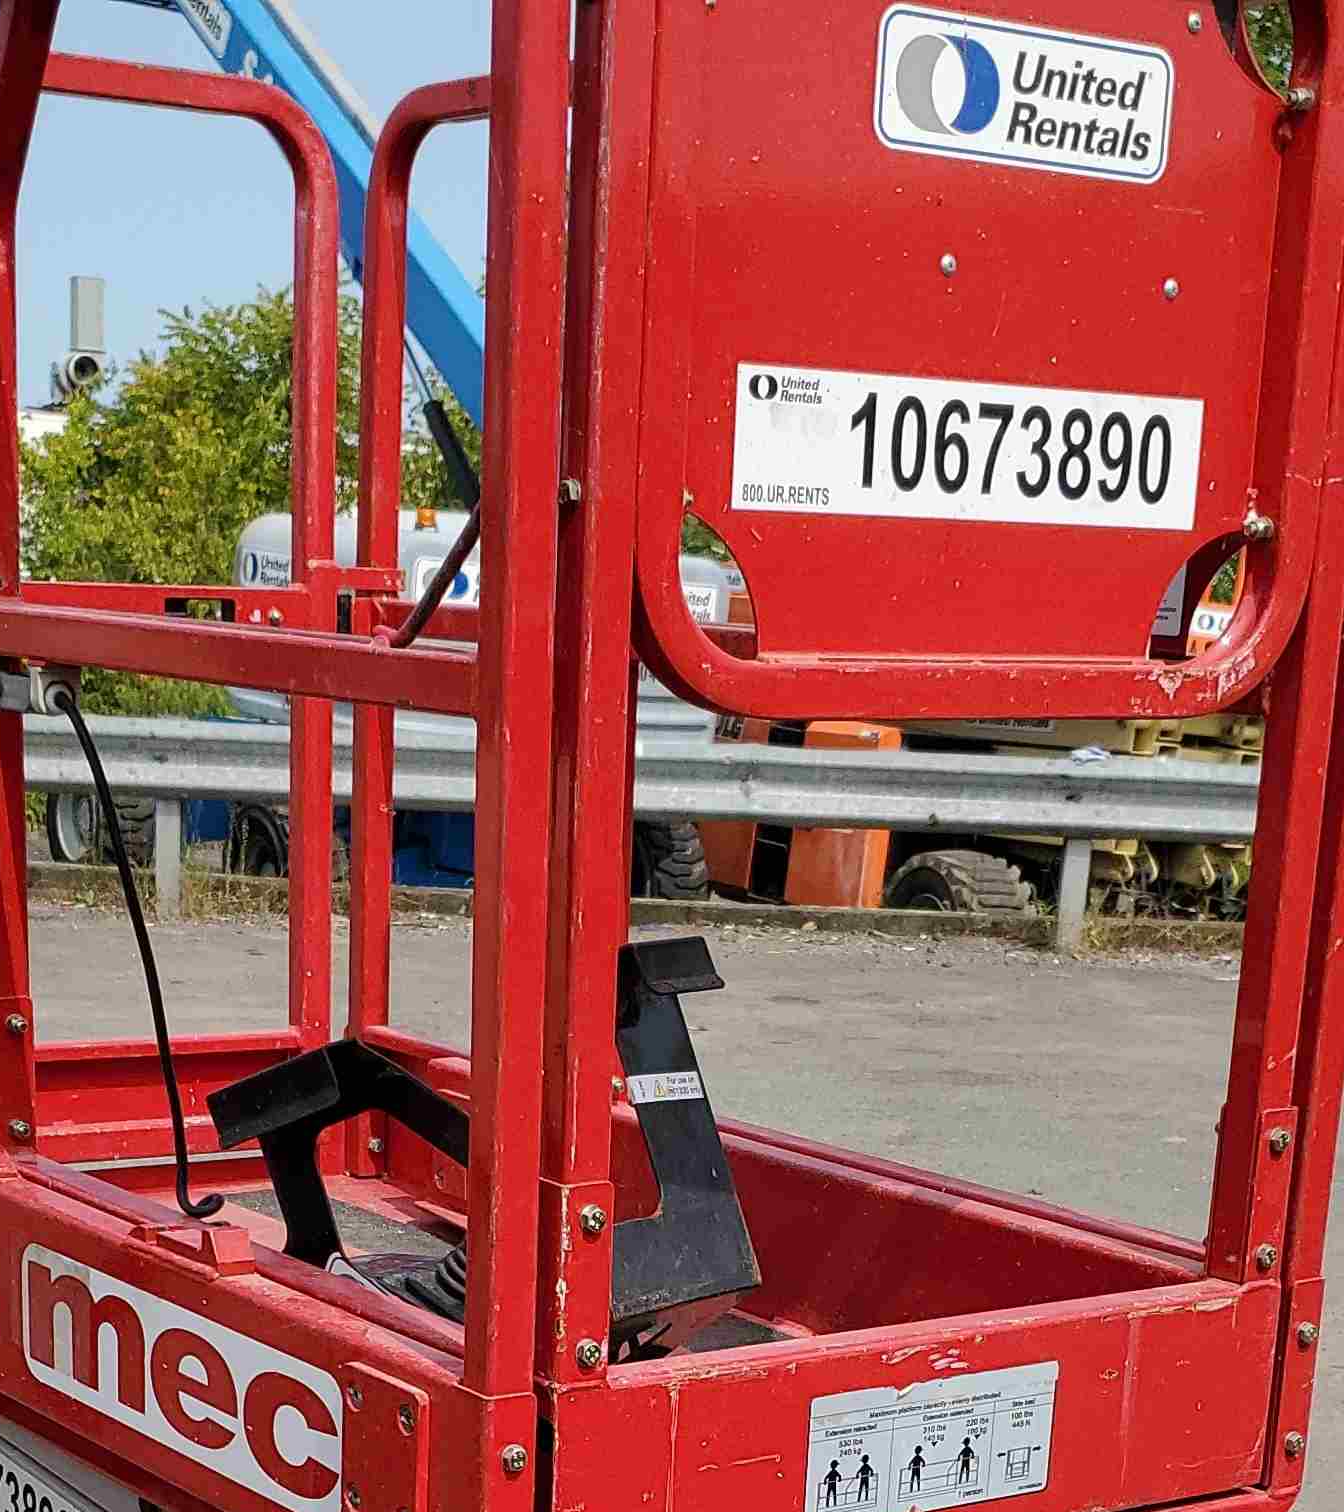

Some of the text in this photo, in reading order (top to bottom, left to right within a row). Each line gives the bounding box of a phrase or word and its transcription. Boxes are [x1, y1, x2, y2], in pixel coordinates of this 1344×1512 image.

[1012, 51, 1147, 112] United
[1006, 101, 1152, 161] Rentals
[780, 389, 823, 404] Rentals
[781, 376, 820, 391] United
[850, 391, 1172, 505] 10673890
[742, 483, 830, 506] 800.UR.RENTS
[24, 1259, 340, 1500] mec
